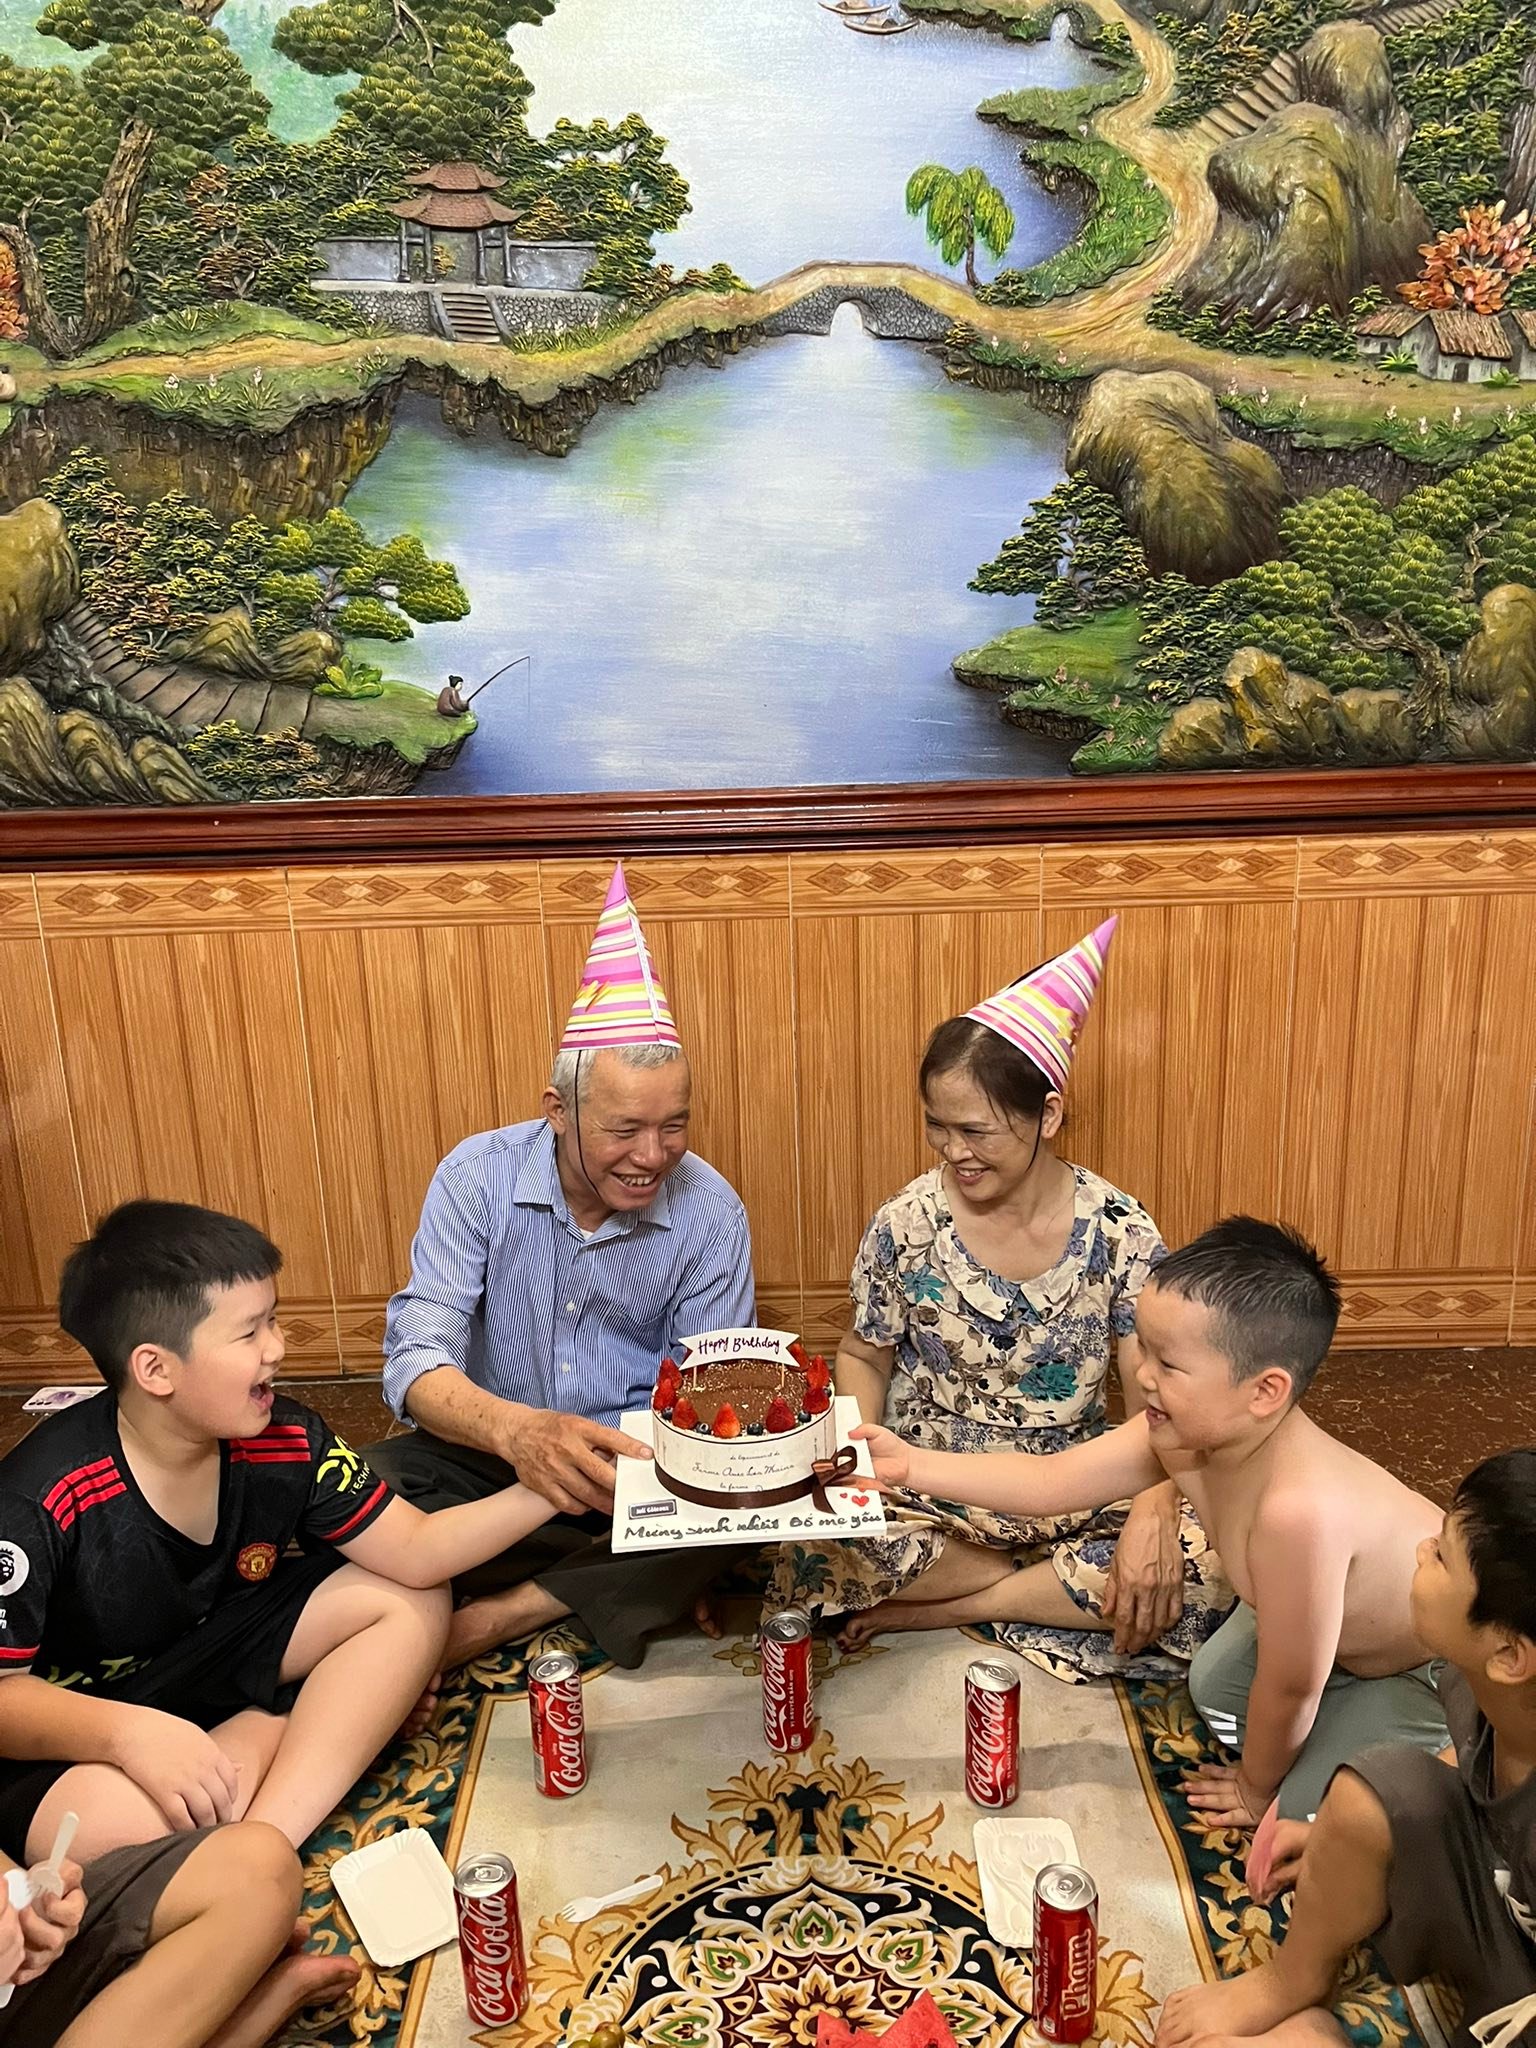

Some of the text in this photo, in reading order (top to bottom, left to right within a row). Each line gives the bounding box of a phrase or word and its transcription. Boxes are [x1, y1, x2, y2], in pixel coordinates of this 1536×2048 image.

[698, 1336, 780, 1355] Happy Birthday
[459, 1893, 519, 2028] Coca-Cola
